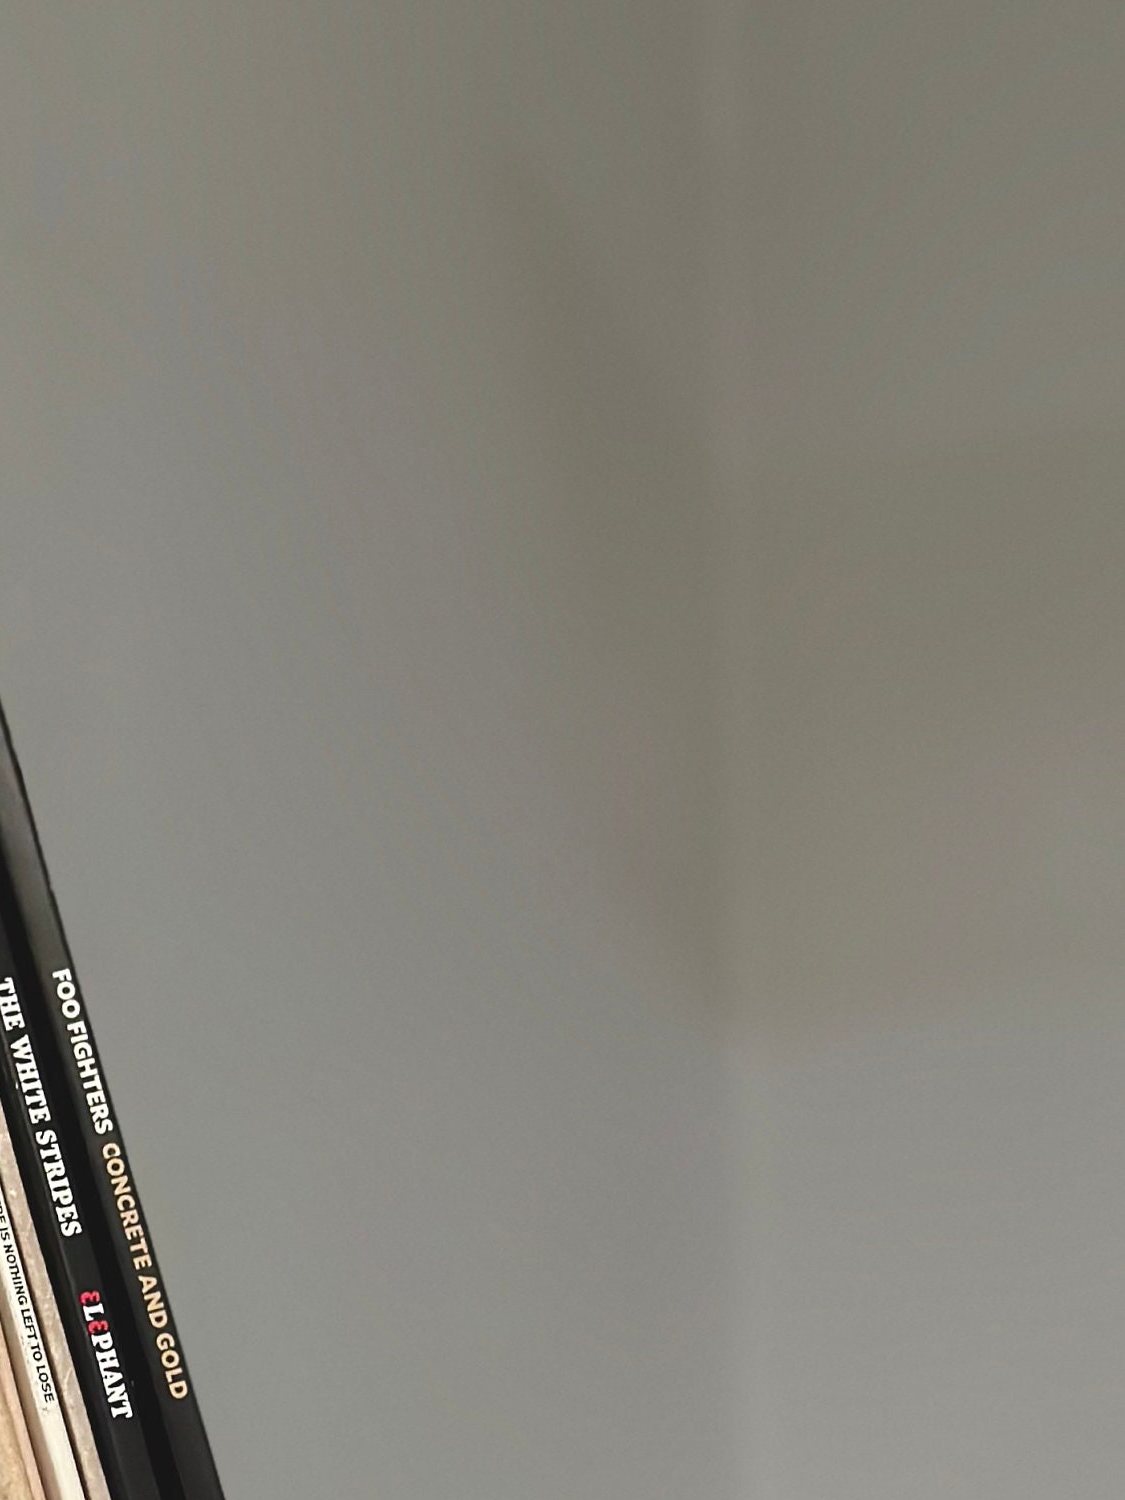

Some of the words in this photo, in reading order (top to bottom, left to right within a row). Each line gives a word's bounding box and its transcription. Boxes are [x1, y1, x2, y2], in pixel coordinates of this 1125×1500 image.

[51, 967, 81, 1019] FOO
[66, 1020, 114, 1136] FIGHTERS
[100, 1141, 153, 1270] CONCRETE
[137, 1272, 169, 1330] AND
[153, 1330, 189, 1401] GOLD
[7, 1033, 51, 1125] WHITE
[33, 1128, 83, 1238] STRIPES
[77, 1289, 133, 1422] ELEPHANT
[1, 1243, 28, 1306] NOTHING
[18, 1307, 38, 1341] LEFT
[27, 1341, 44, 1362] TO
[34, 1363, 56, 1403] LOSE
